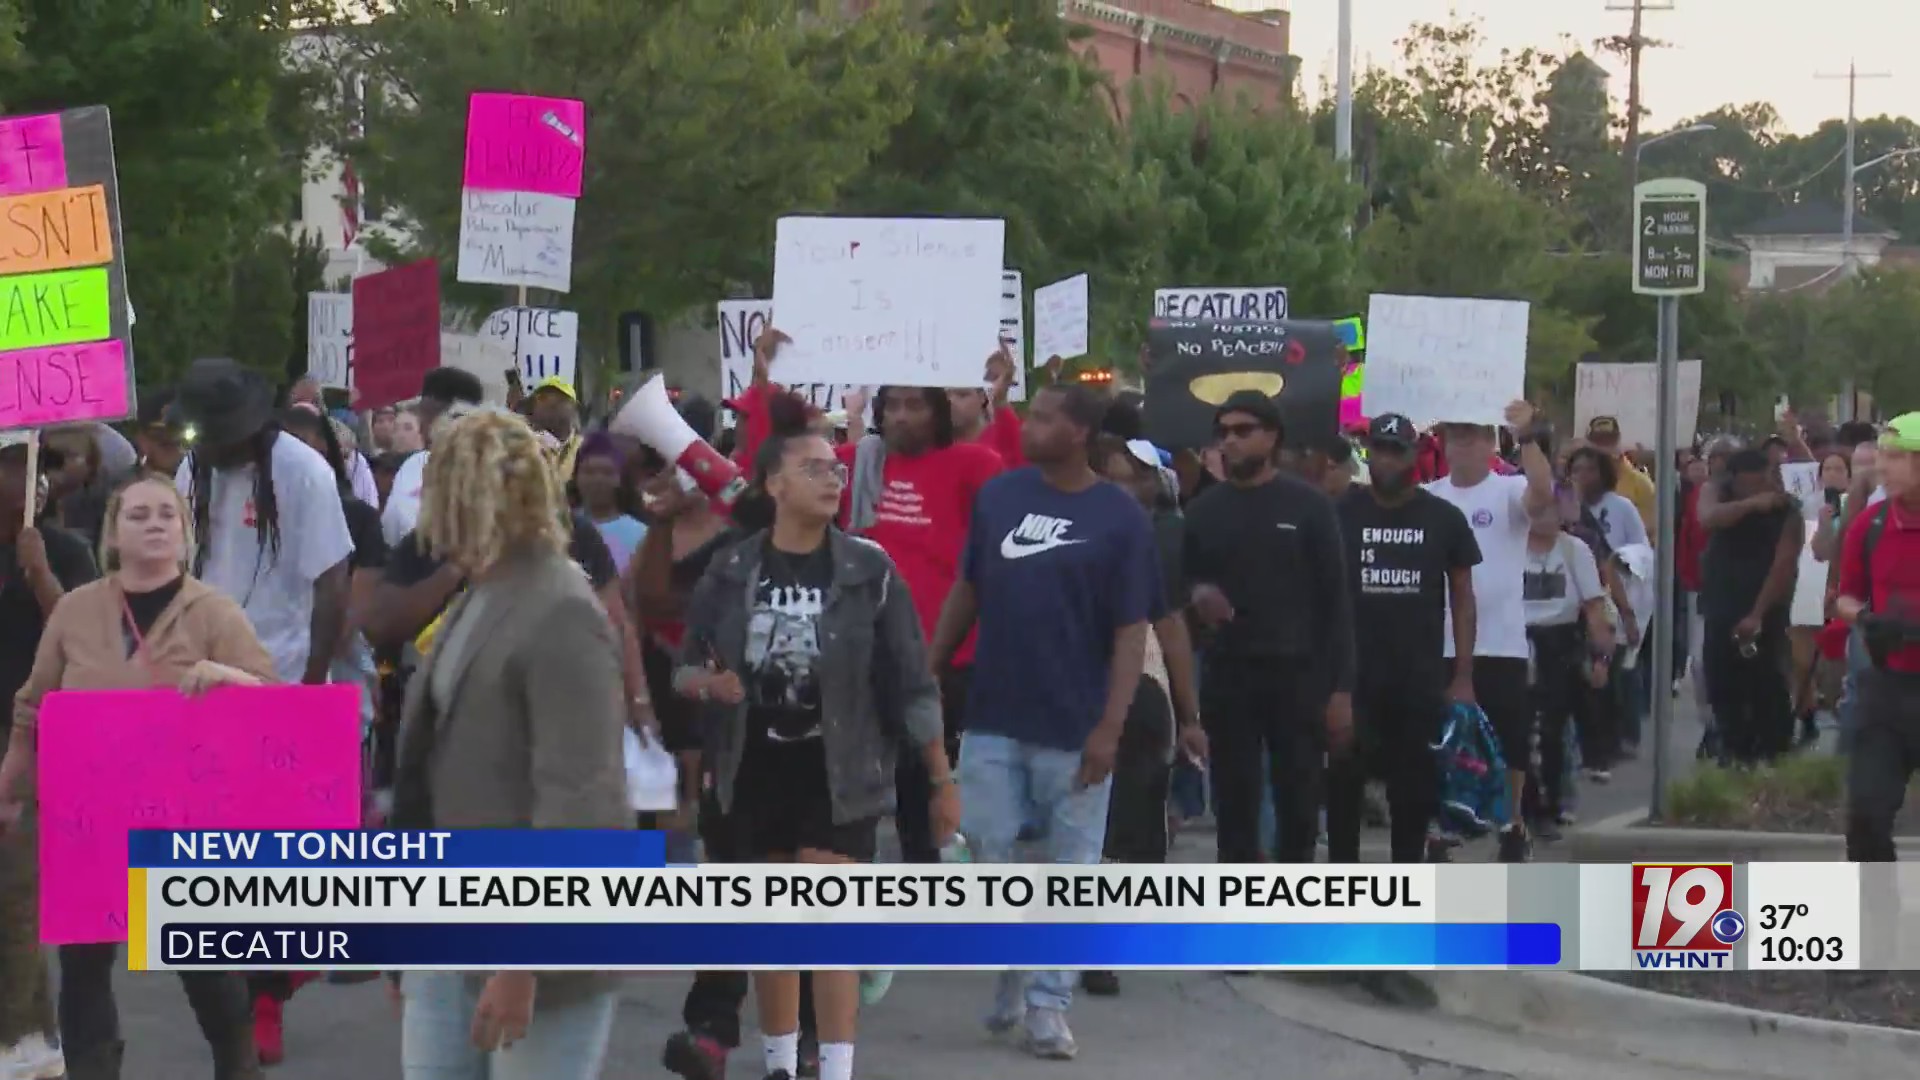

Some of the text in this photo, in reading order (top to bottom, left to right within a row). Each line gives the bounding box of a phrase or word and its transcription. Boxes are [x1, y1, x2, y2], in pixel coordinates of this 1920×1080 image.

[0, 190, 100, 262] SN'T
[1644, 211, 1690, 235] 2 HOUR
[1657, 223, 1697, 235] PARKING
[0, 278, 90, 338] AKE
[1156, 289, 1287, 320] DECATUR PD
[1212, 322, 1286, 336] JUSTICE
[1176, 341, 1202, 356] NO
[1015, 512, 1073, 541] NIKE
[1363, 527, 1424, 545] ENOUGH
[1361, 547, 1375, 563] IS
[1361, 567, 1421, 585] ENOUGH
